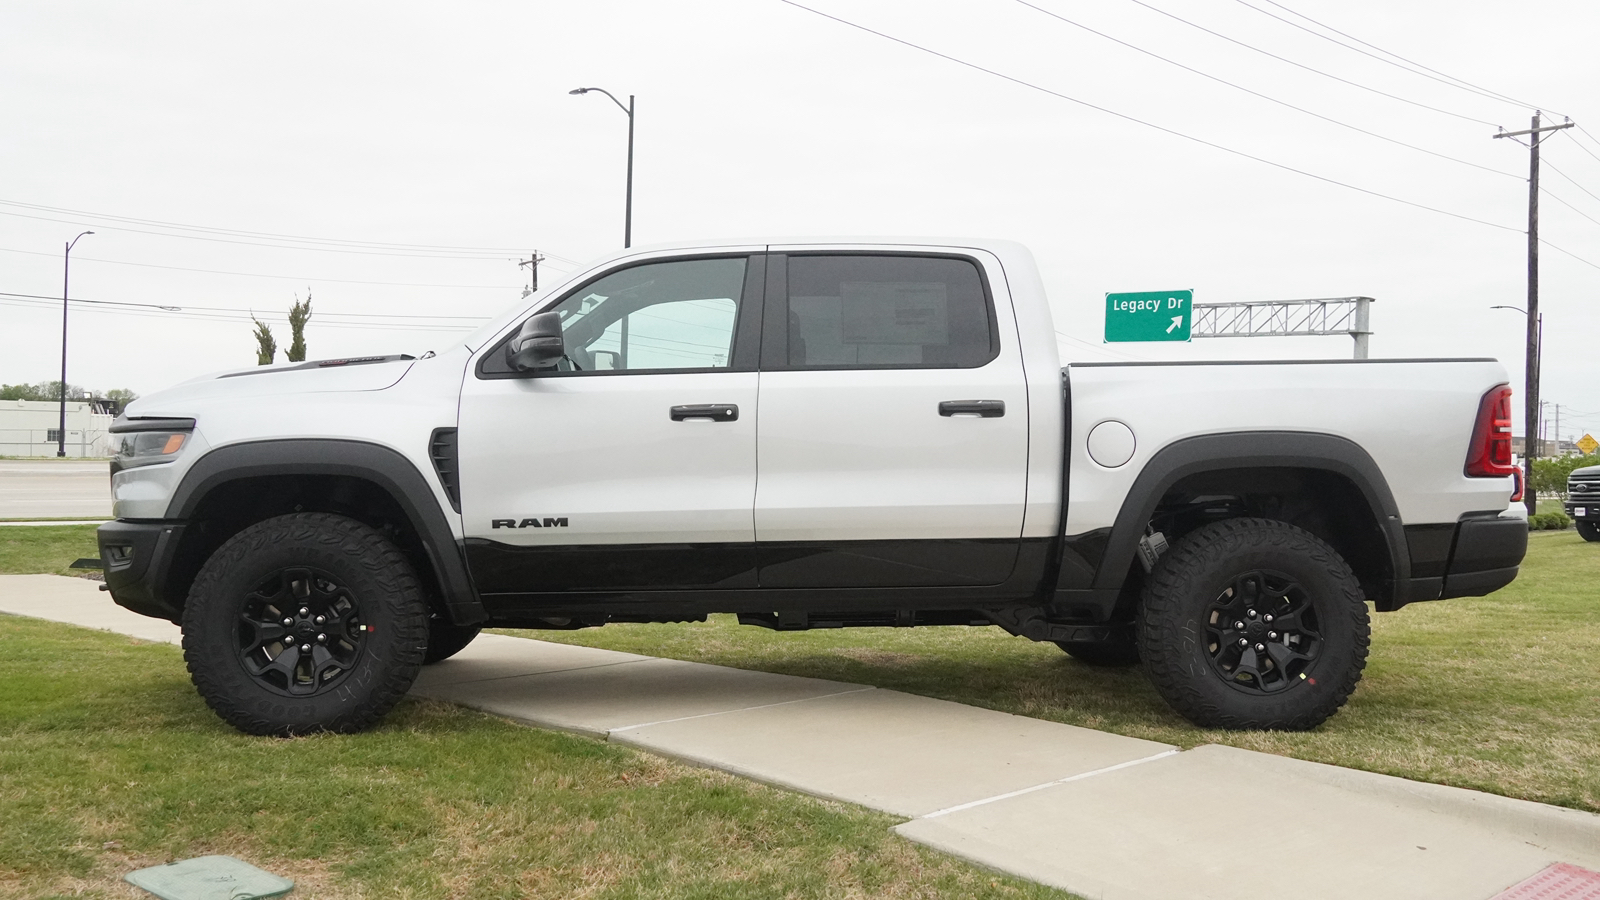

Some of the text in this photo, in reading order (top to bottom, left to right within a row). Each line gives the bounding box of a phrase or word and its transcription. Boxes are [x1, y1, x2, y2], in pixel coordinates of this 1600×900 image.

[1113, 297, 1184, 313] Legacy Dr
[491, 517, 569, 529] RAM
